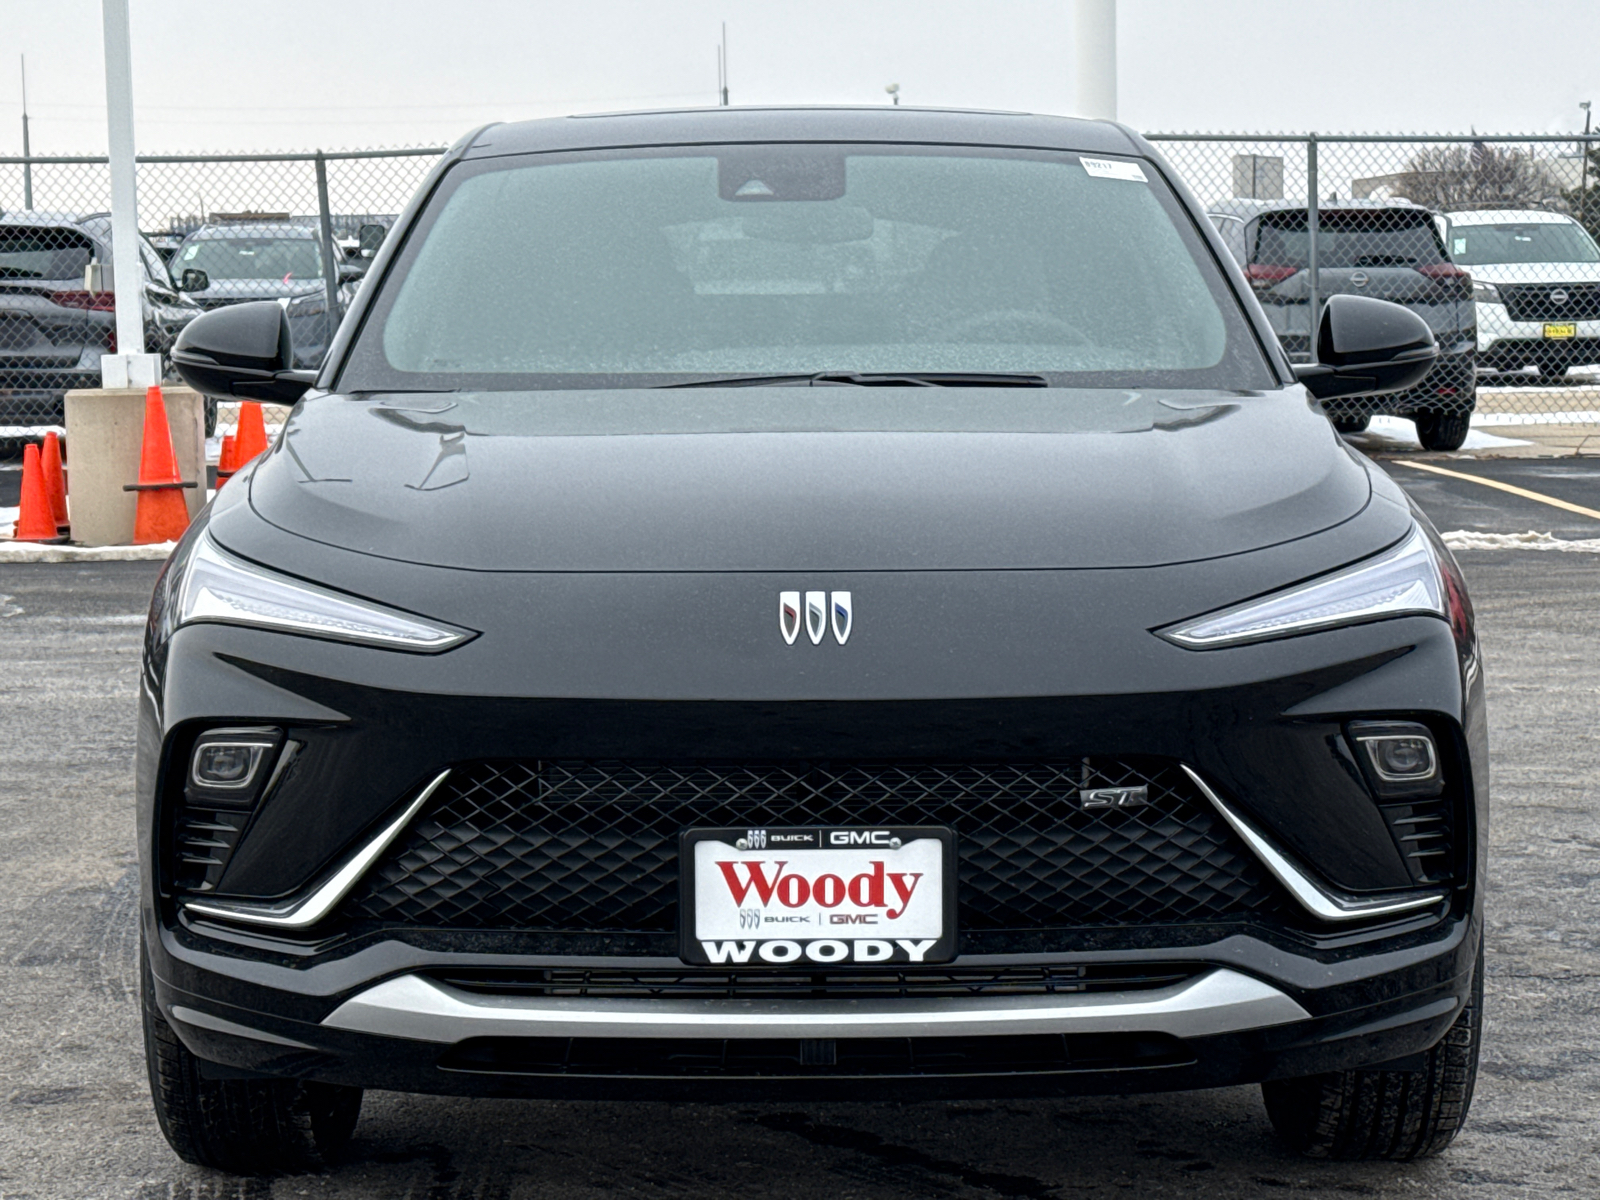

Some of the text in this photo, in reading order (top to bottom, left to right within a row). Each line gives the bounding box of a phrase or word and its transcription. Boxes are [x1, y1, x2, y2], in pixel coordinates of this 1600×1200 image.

[1083, 787, 1143, 808] ST
[771, 831, 891, 845] BUICK GMC
[715, 861, 924, 919] Woody
[764, 914, 879, 924] BUICK GMC
[701, 940, 937, 963] WOODY
